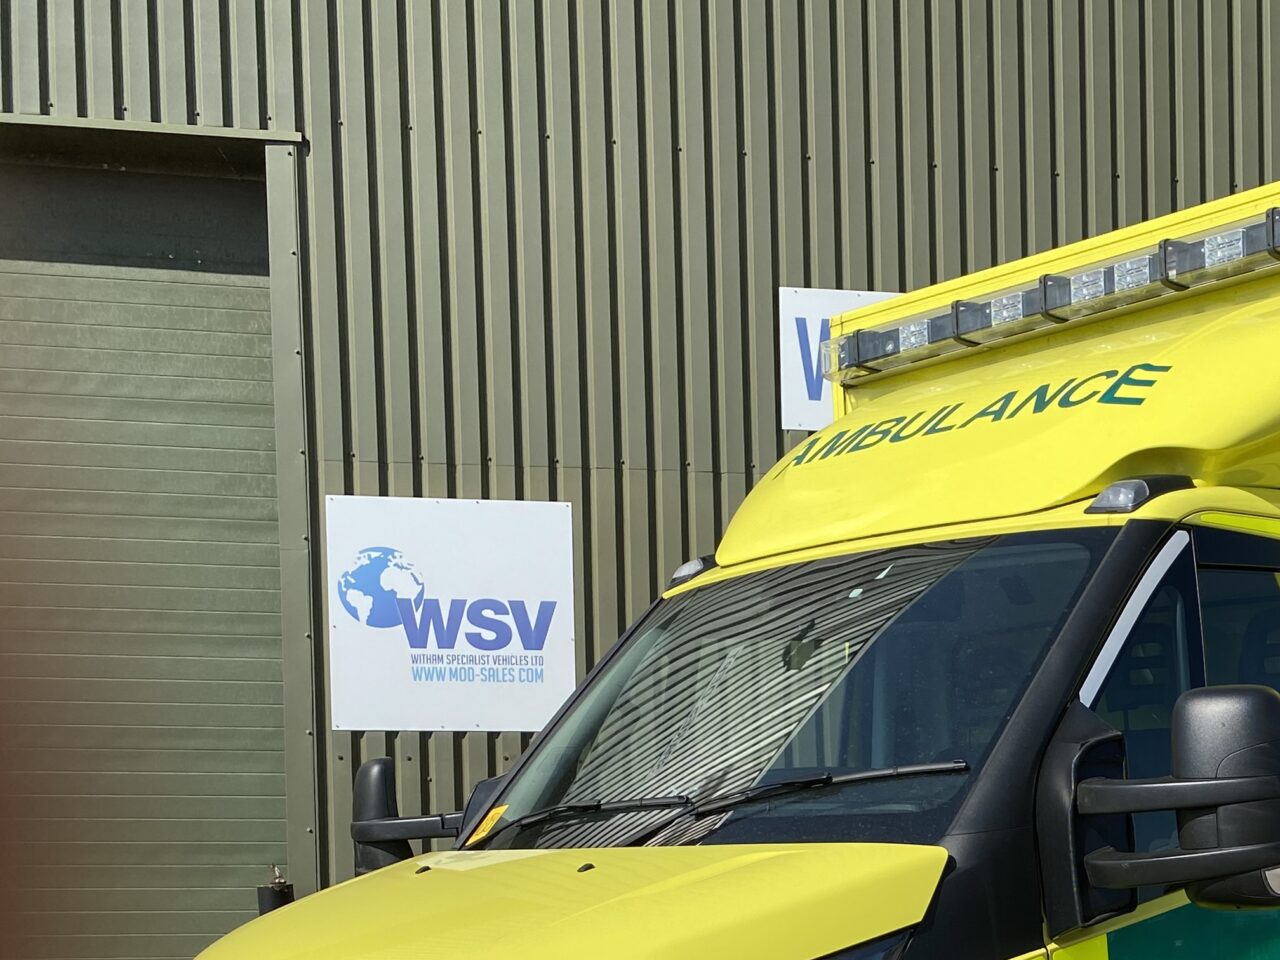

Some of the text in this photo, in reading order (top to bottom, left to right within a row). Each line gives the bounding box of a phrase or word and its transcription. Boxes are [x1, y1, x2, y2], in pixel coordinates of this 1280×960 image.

[772, 363, 1173, 480] AMBULANCE
[395, 598, 557, 651] WSV
[411, 653, 544, 666] WITHAM SPECIALIST VEHICLES LTD
[411, 666, 544, 683] WWWMOD-SALESCOM
